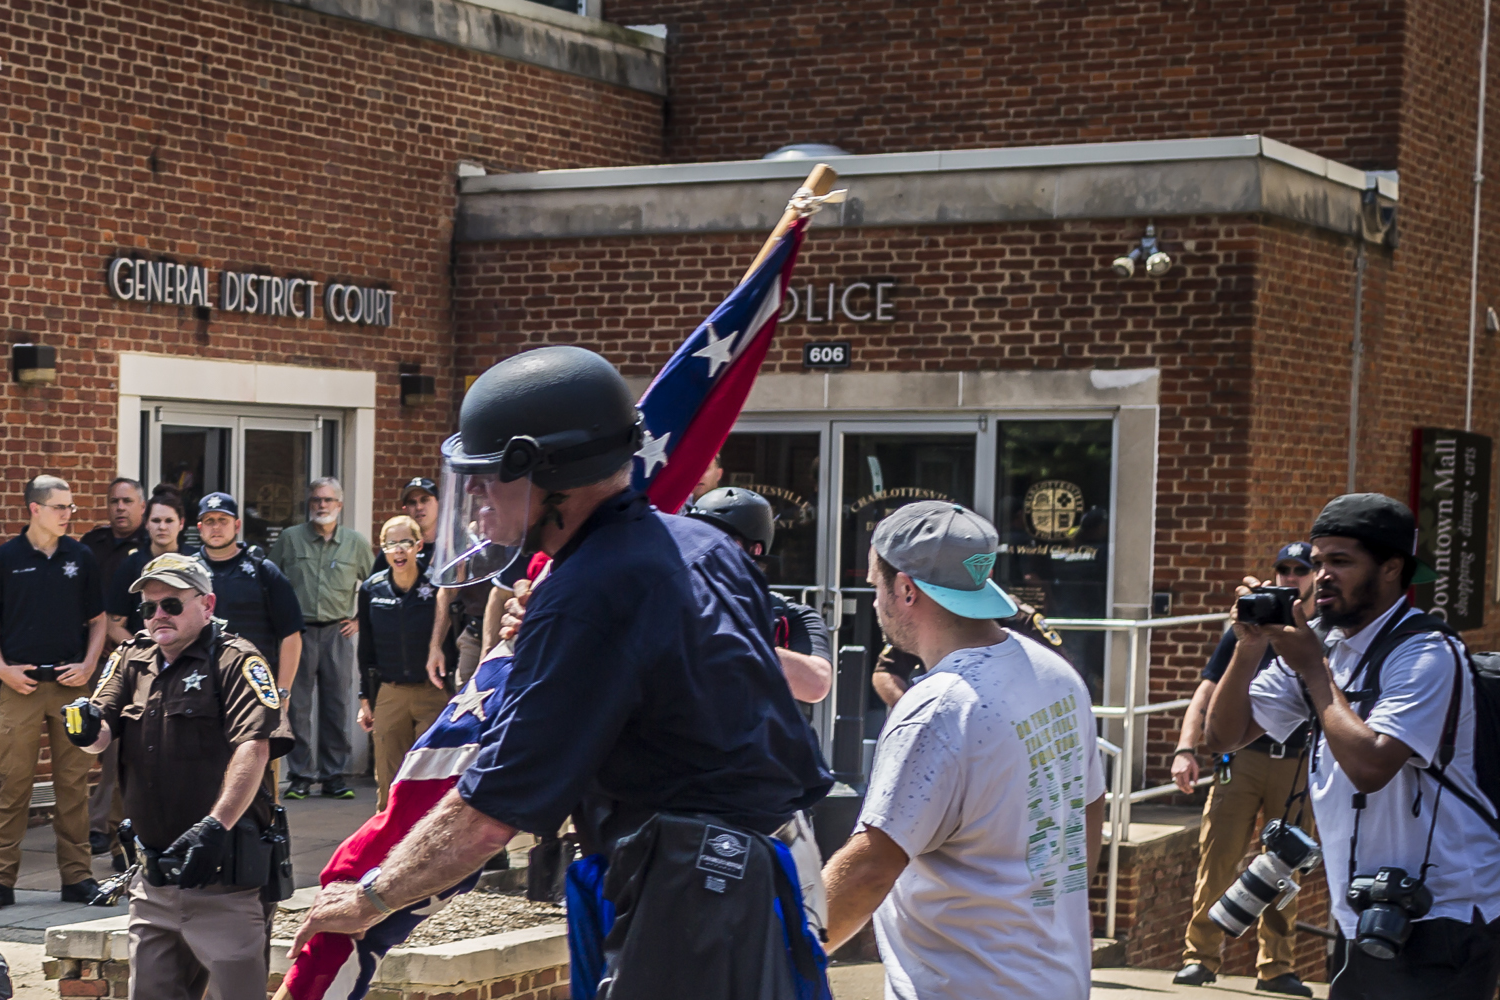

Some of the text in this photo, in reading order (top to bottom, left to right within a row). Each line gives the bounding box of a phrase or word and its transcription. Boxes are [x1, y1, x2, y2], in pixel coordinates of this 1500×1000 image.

[109, 257, 397, 327] GENERAL DISTRICT COURT
[809, 347, 844, 362] 606
[1433, 438, 1457, 492] Mall
[1454, 446, 1478, 617] shopping dining arts
